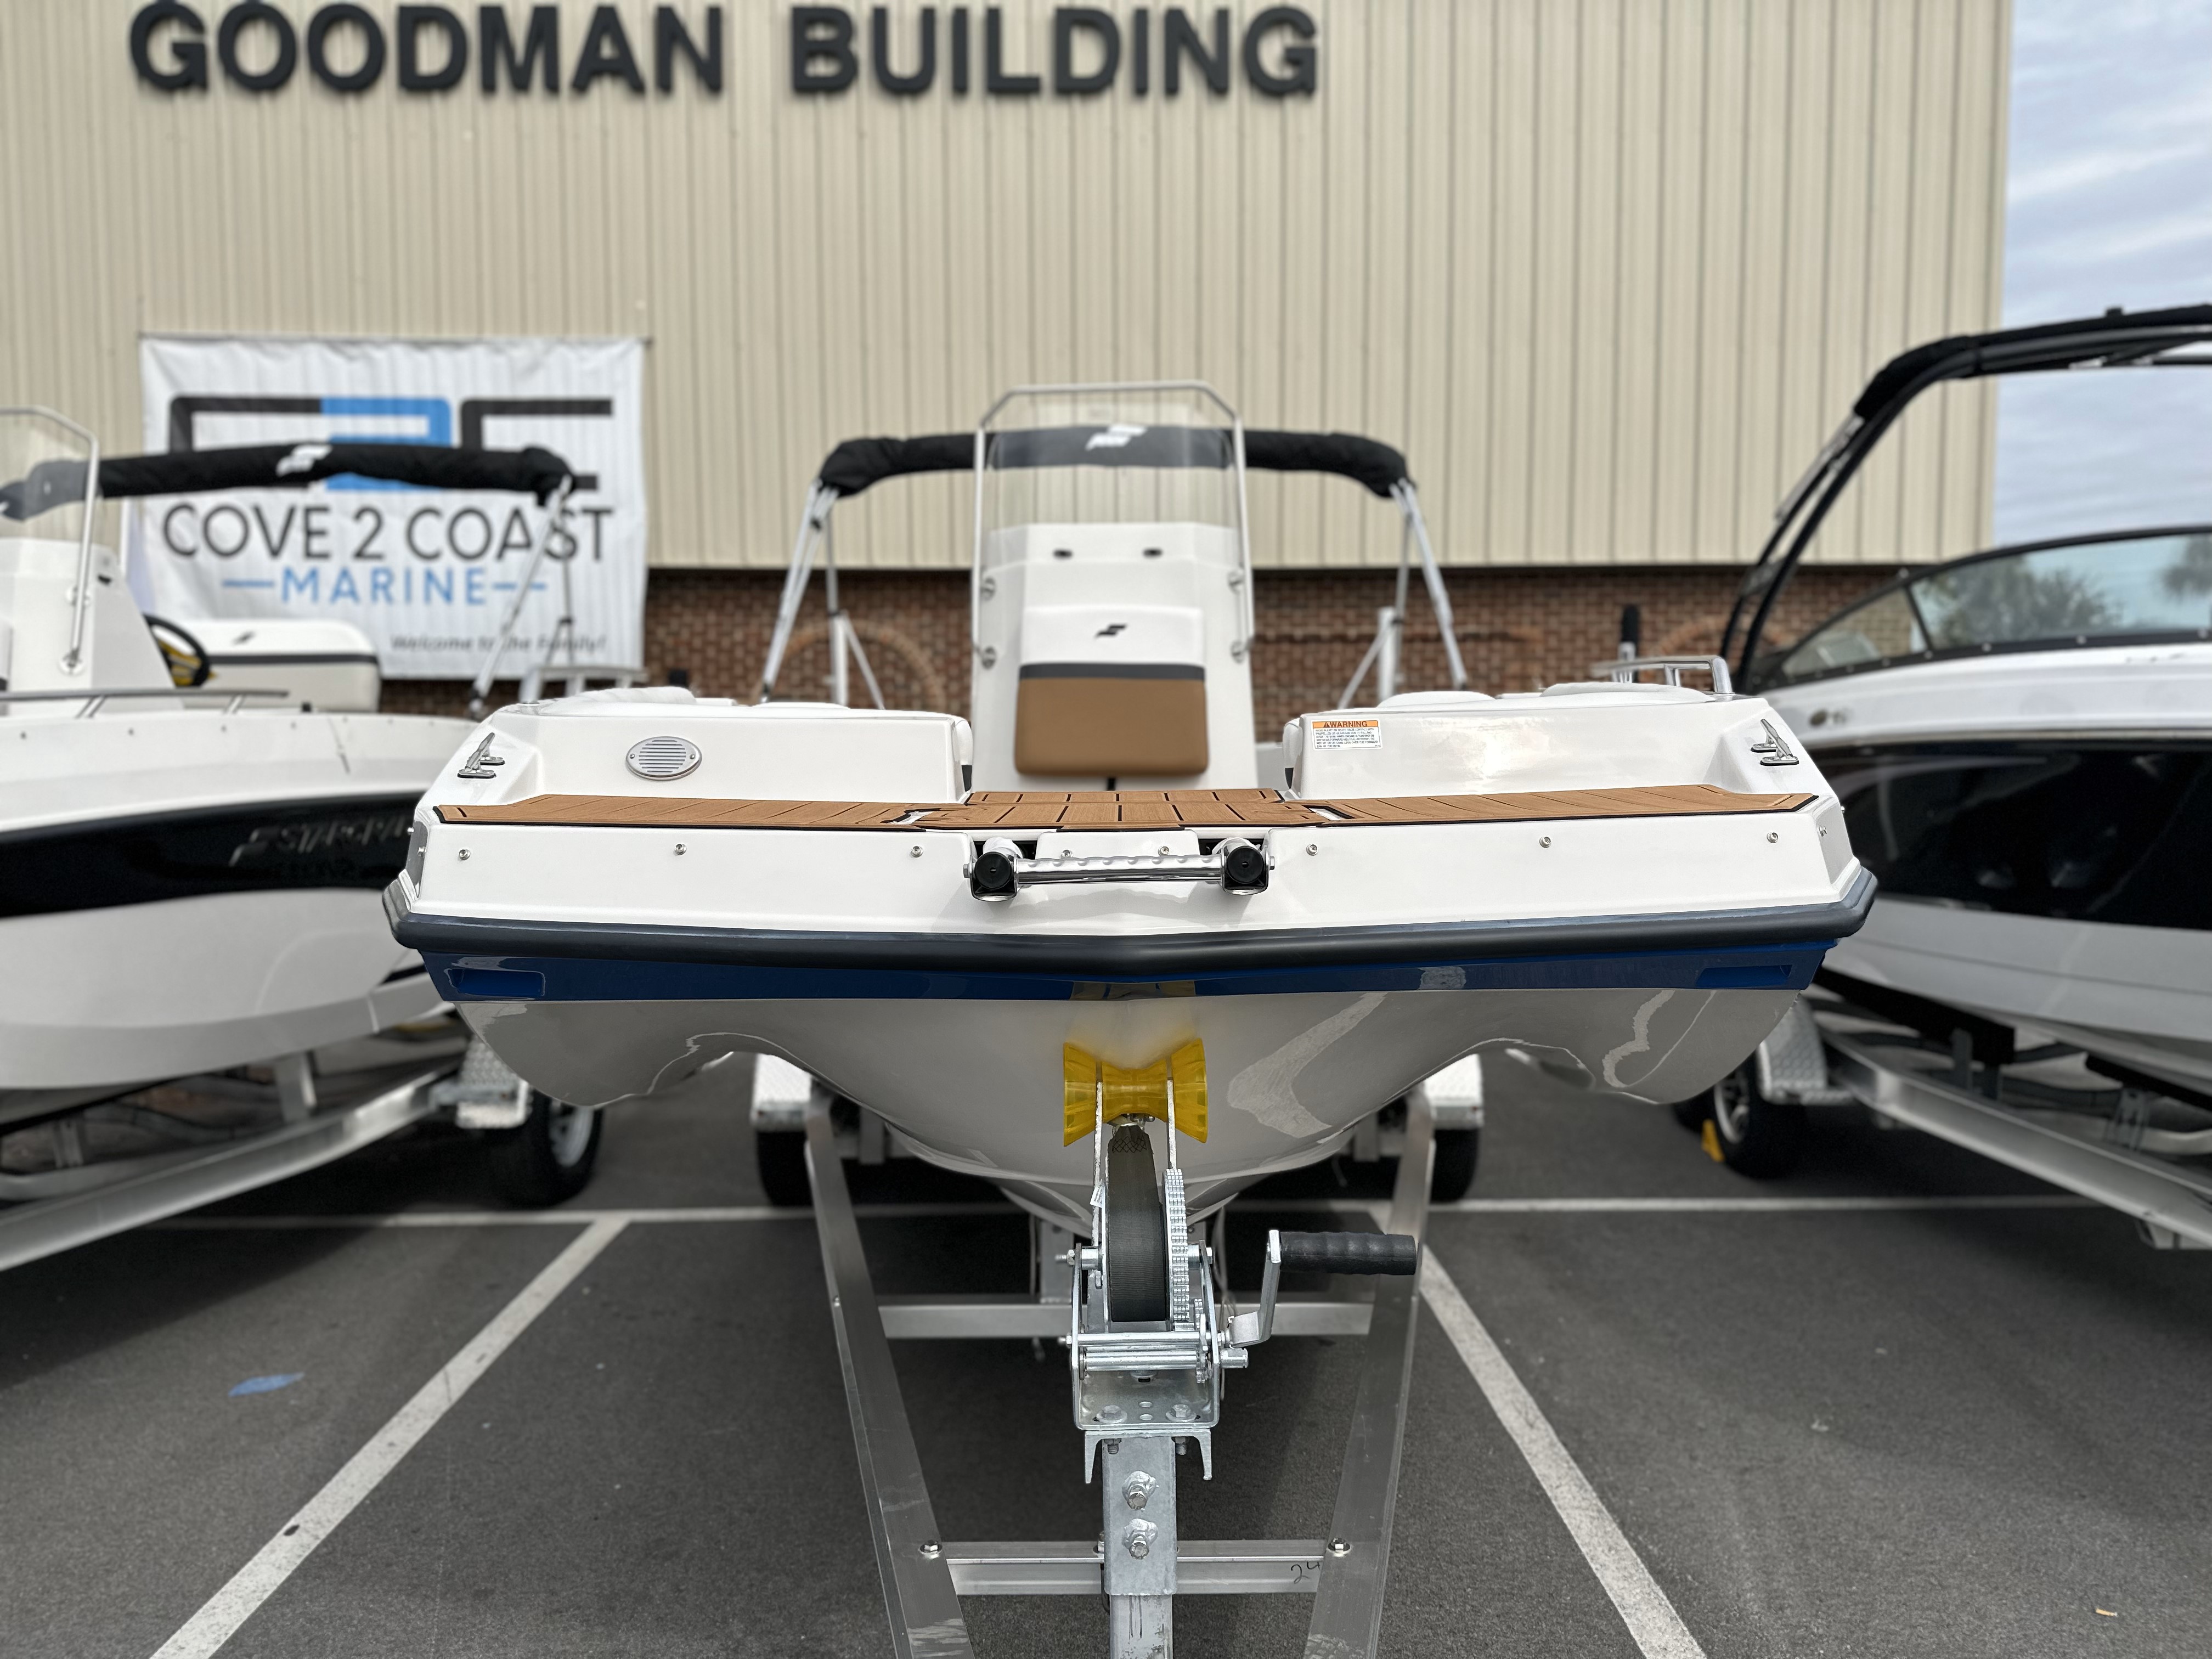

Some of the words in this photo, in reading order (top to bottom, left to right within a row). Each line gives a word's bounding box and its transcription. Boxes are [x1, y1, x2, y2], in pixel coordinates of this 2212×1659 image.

[129, 0, 723, 94] GOODMAN
[790, 4, 1317, 97] BUILDING
[162, 503, 334, 558] COVE
[353, 506, 384, 560] 2
[406, 506, 613, 562] COAST
[281, 567, 487, 605] MARINE
[1290, 1561, 1321, 1584] 24
